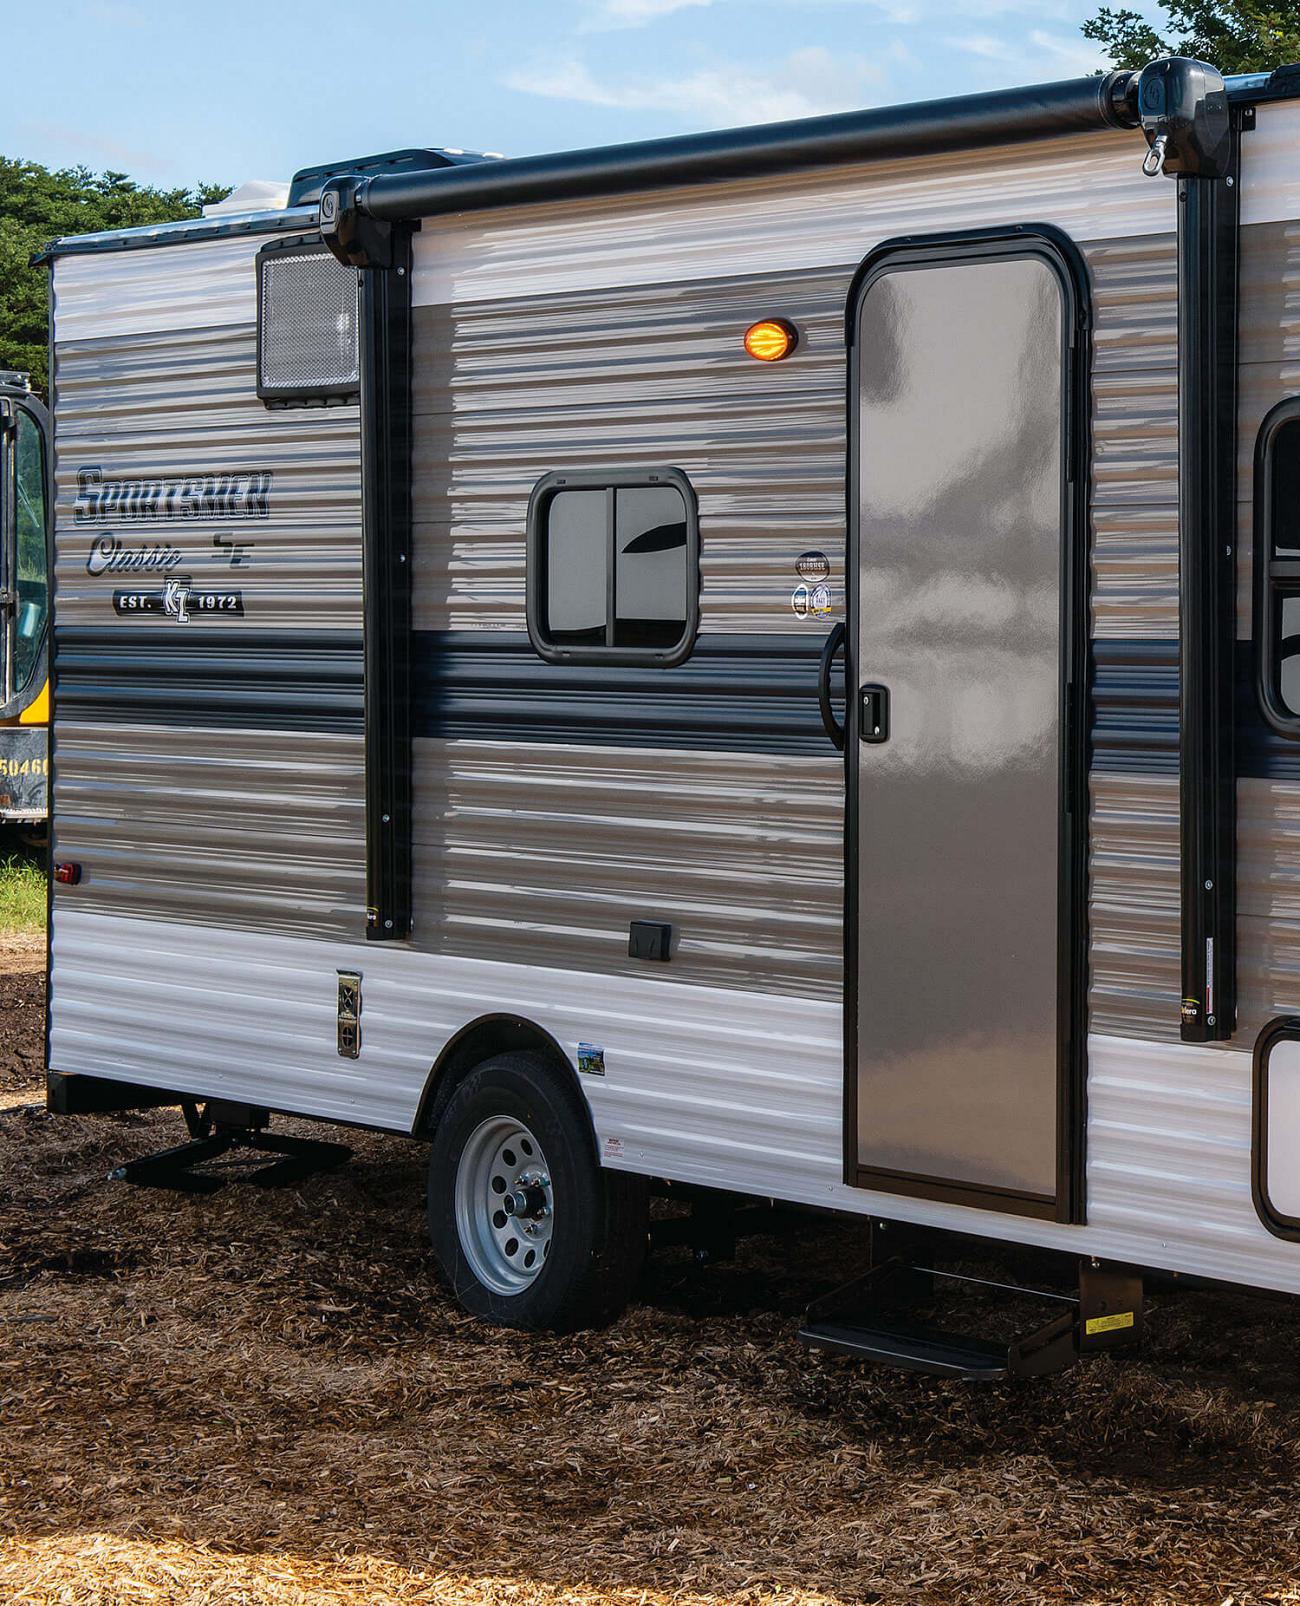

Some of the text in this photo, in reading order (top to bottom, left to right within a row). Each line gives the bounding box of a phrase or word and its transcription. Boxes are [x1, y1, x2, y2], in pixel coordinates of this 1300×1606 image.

[73, 464, 274, 525] SPORTSMEN
[86, 531, 255, 577] Classic SE
[119, 578, 237, 623] EST. KZ 1972
